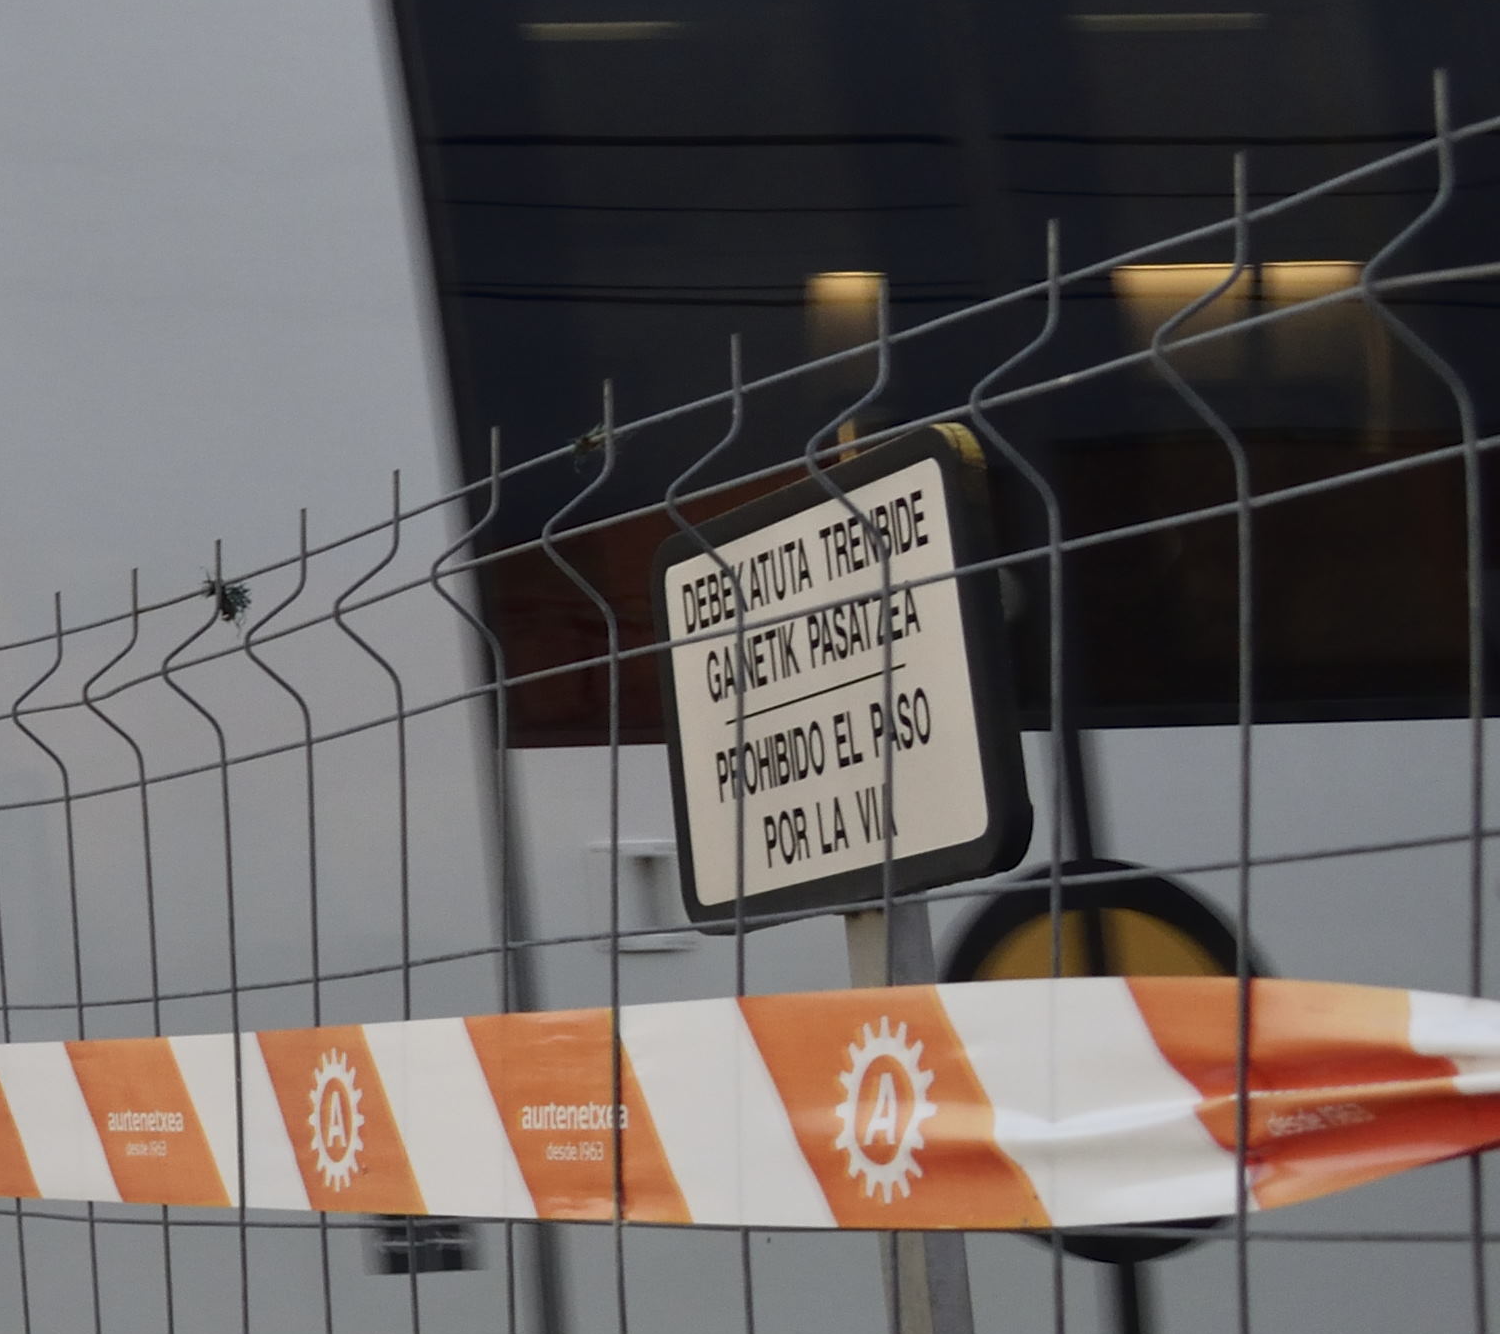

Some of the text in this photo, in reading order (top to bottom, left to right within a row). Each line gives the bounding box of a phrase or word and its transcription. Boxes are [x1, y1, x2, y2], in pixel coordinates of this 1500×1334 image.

[682, 490, 929, 634] DEBEKATUTA TRENBIDE
[707, 622, 800, 703] GANETIK
[833, 711, 864, 768] EL
[763, 807, 810, 868] POR
[816, 796, 849, 855] LA
[108, 1109, 184, 1132] aurtenetxea
